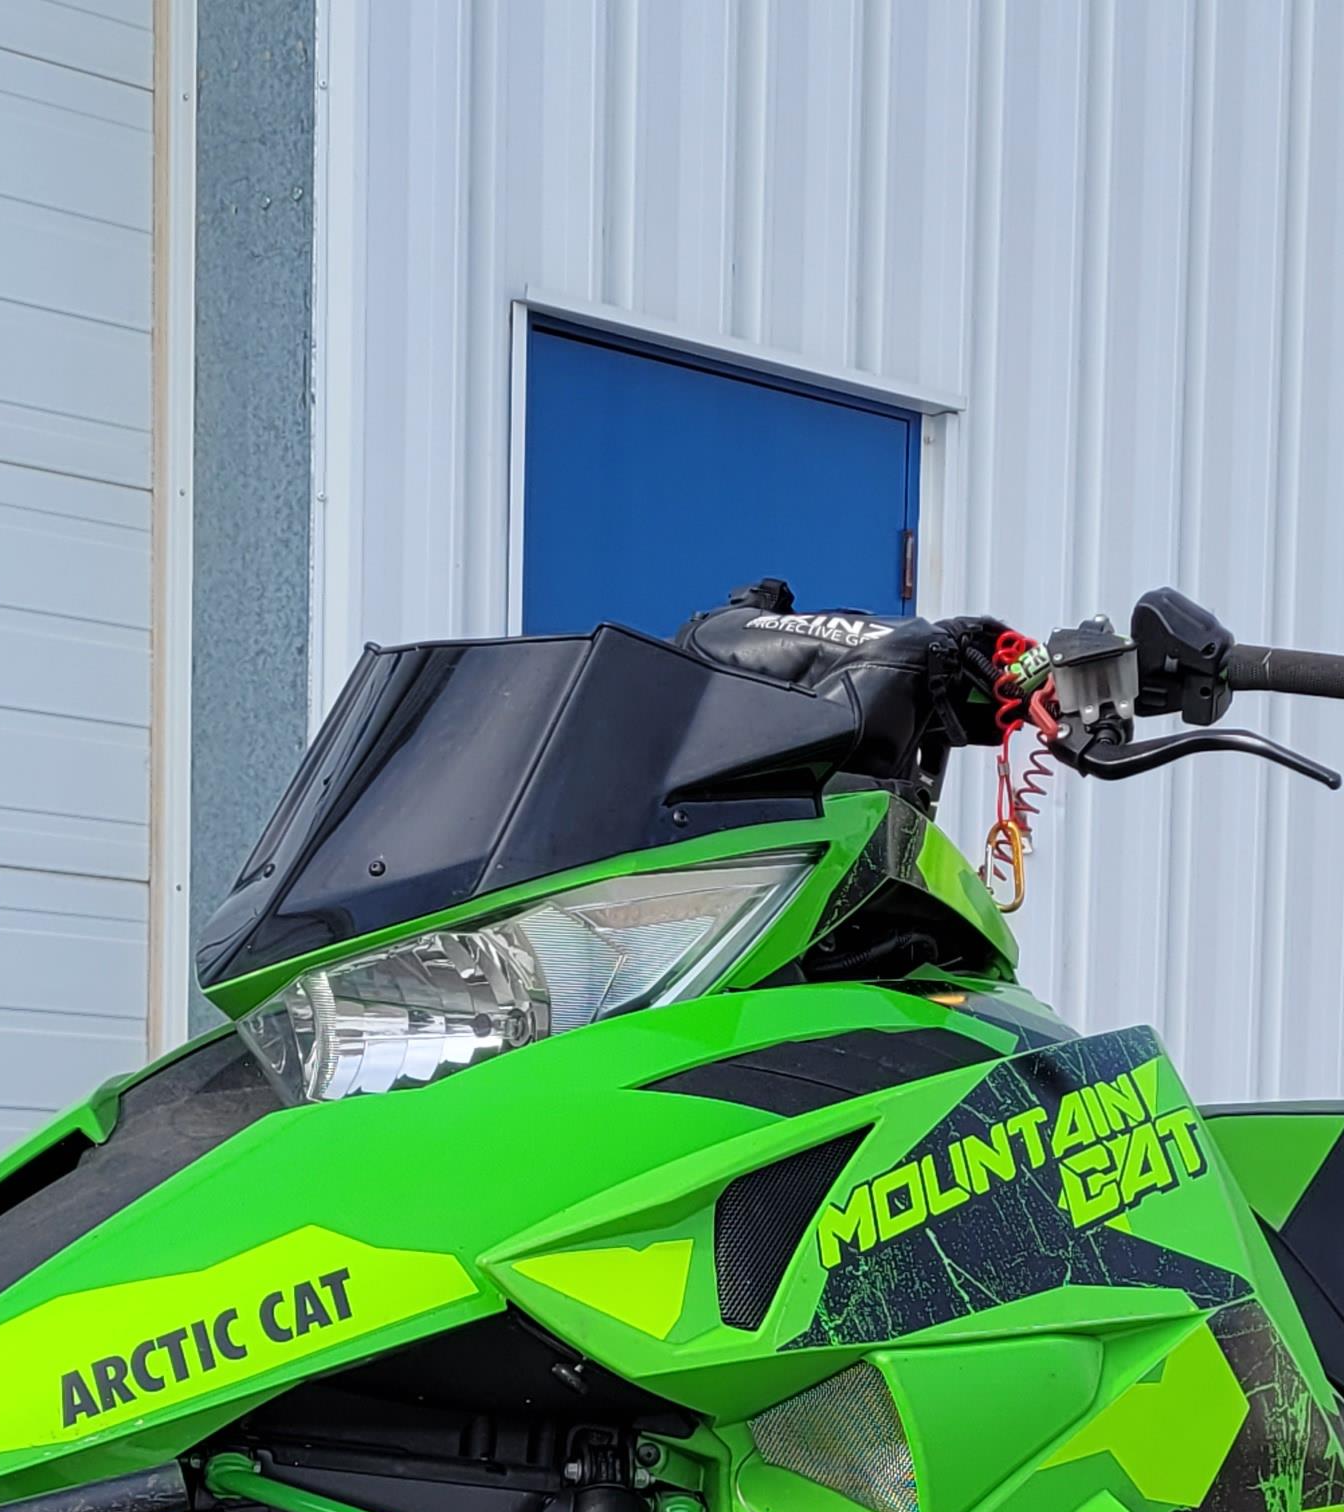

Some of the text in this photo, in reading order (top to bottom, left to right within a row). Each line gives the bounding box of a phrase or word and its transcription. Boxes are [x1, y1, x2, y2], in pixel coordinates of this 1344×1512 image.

[816, 1058, 1158, 1269] MOUNTAIN
[1059, 1107, 1202, 1229] CAT
[61, 1267, 352, 1428] ARCTIC CAT
